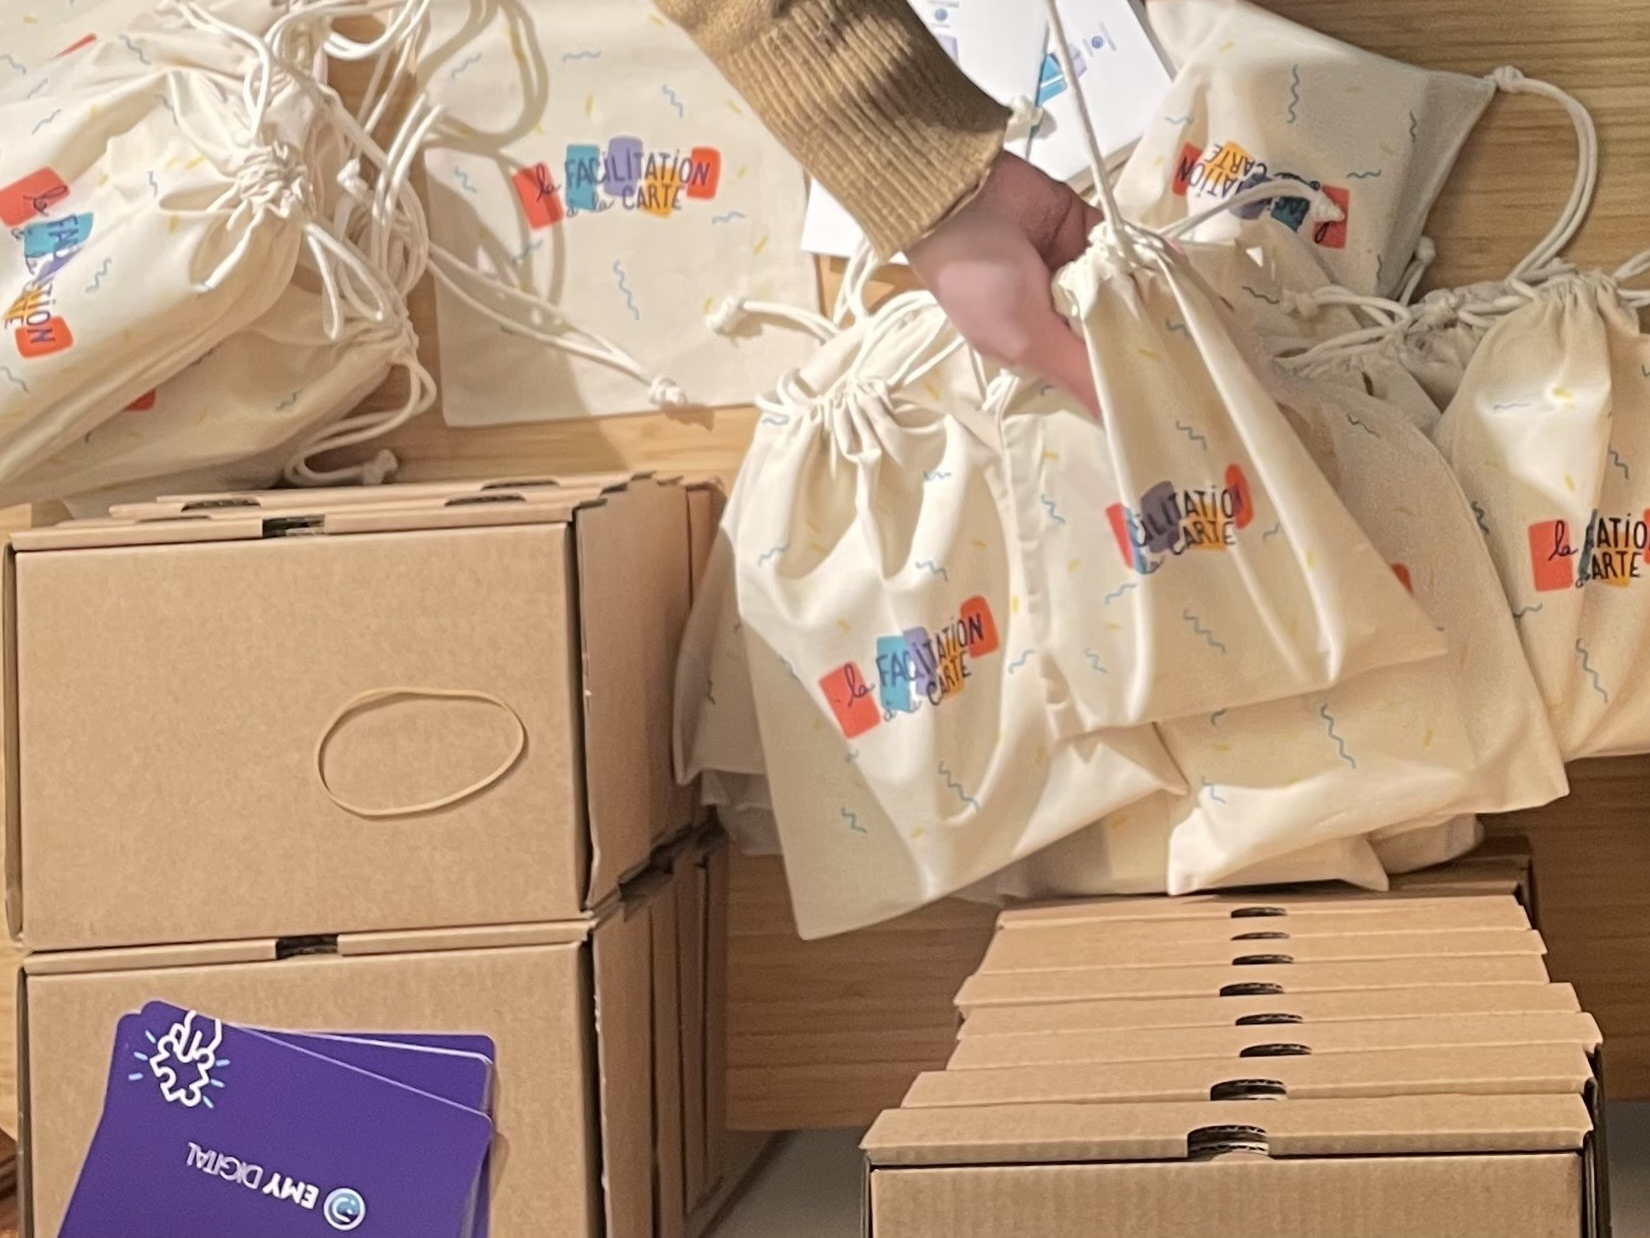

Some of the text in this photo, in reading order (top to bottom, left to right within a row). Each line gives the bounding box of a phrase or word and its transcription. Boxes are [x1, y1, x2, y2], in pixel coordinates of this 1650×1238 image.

[1204, 143, 1268, 176] CARTE
[536, 163, 562, 202] la
[622, 184, 684, 211] CARTE
[1548, 520, 1579, 561] la
[1592, 550, 1642, 580] ARTE
[843, 663, 876, 708] la
[187, 1141, 320, 1210] EMY DIGITAL
